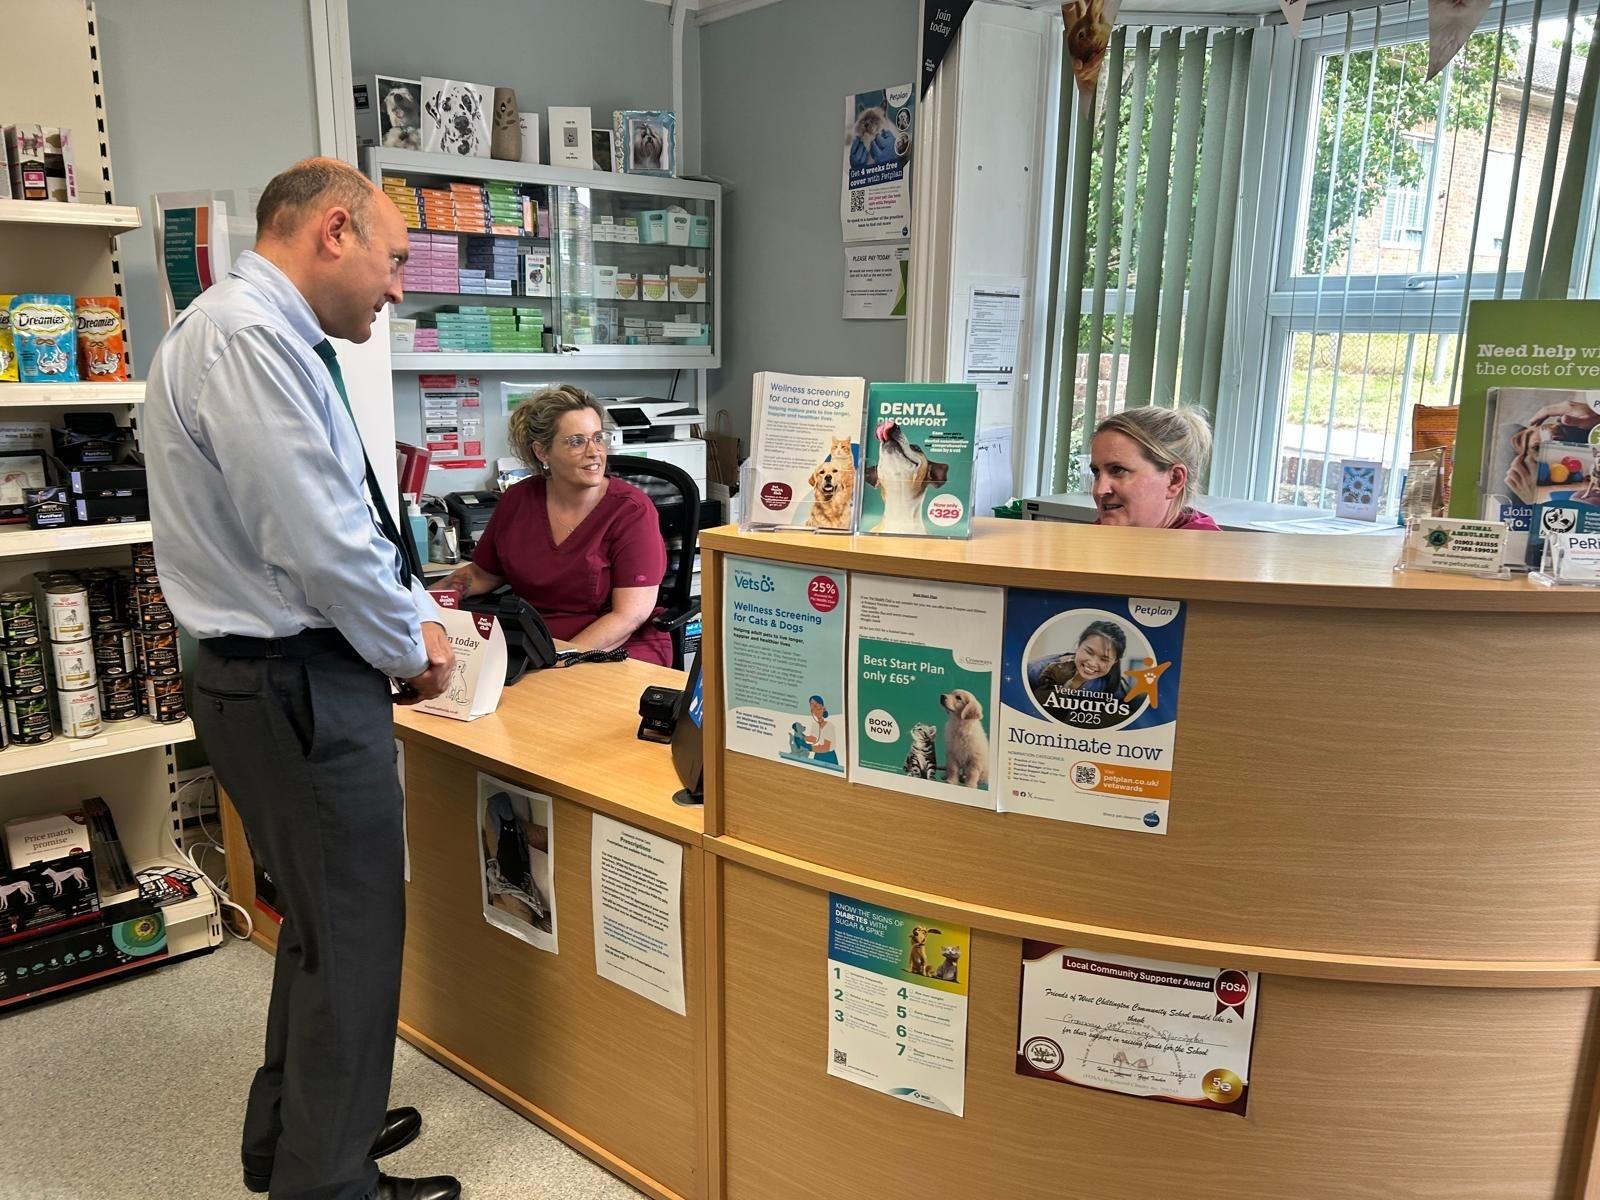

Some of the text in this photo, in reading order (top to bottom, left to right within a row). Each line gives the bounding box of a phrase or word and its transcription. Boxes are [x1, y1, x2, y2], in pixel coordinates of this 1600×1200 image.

[936, 9, 951, 22] Join
[930, 22, 951, 37] today
[890, 92, 908, 100] Petplan
[850, 170, 860, 178] Get
[866, 164, 885, 174] weeks
[886, 162, 898, 170] free
[850, 170, 902, 187] cover with Petplan
[19, 313, 64, 327] Dreamies
[77, 317, 115, 329] Dreamies
[1477, 344, 1600, 360] Need help wi
[1476, 362, 1600, 376] the cost of ve
[771, 382, 850, 398] Wellness screening
[770, 394, 844, 409] for cats and dogs
[880, 402, 945, 416] DENTAL
[1503, 507, 1532, 516] Join
[1451, 531, 1500, 539] AMBULANCE
[735, 575, 759, 590] Vets
[812, 582, 835, 594] 25%
[734, 601, 822, 625] Wellness Screening
[1134, 604, 1172, 617] Petplan
[734, 612, 746, 622] for
[749, 616, 768, 626] Cats
[780, 621, 803, 633] Dogs
[455, 637, 480, 650] today
[863, 655, 945, 674] Best Start Plan
[863, 671, 887, 684] only
[1053, 685, 1113, 702] Veterinary
[1042, 691, 1130, 716] Awards
[868, 718, 893, 728] BOOK
[1069, 711, 1102, 725] 2025
[870, 726, 892, 735] NOW
[1008, 727, 1163, 761] Nominate now
[1103, 782, 1143, 792] vetawards
[24, 827, 74, 843] Price match
[33, 837, 68, 850] promise
[620, 837, 651, 852] Prescriptions
[836, 903, 857, 914] KNOW
[858, 908, 871, 917] THE
[872, 914, 893, 924] SIGNS
[836, 910, 888, 930] DIABETES WITH
[835, 917, 858, 928] SUGAR
[866, 927, 885, 938] SPIKE
[834, 968, 840, 979] 1
[1066, 960, 1210, 989] Local Community Supporter Award
[897, 987, 908, 1000] 4
[1221, 982, 1246, 993] FOSA
[834, 989, 843, 1001] 2
[897, 1005, 907, 1018] 5
[1045, 988, 1068, 999] Friends
[1070, 994, 1077, 1002] of
[1078, 995, 1095, 1004] West
[1132, 1003, 1167, 1016] Community
[1169, 1009, 1191, 1018] School
[1212, 1015, 1224, 1023] like
[835, 1010, 844, 1022] 3
[1127, 1015, 1145, 1023] thank
[896, 1024, 907, 1038] 6
[1062, 1026, 1071, 1034] for
[1073, 1028, 1086, 1036] their
[1088, 1032, 1112, 1040] support
[1121, 1038, 1143, 1048] raising
[1144, 1041, 1161, 1050] funds
[1164, 1043, 1173, 1052] for
[1186, 1046, 1209, 1056] School
[896, 1043, 906, 1056] 7
